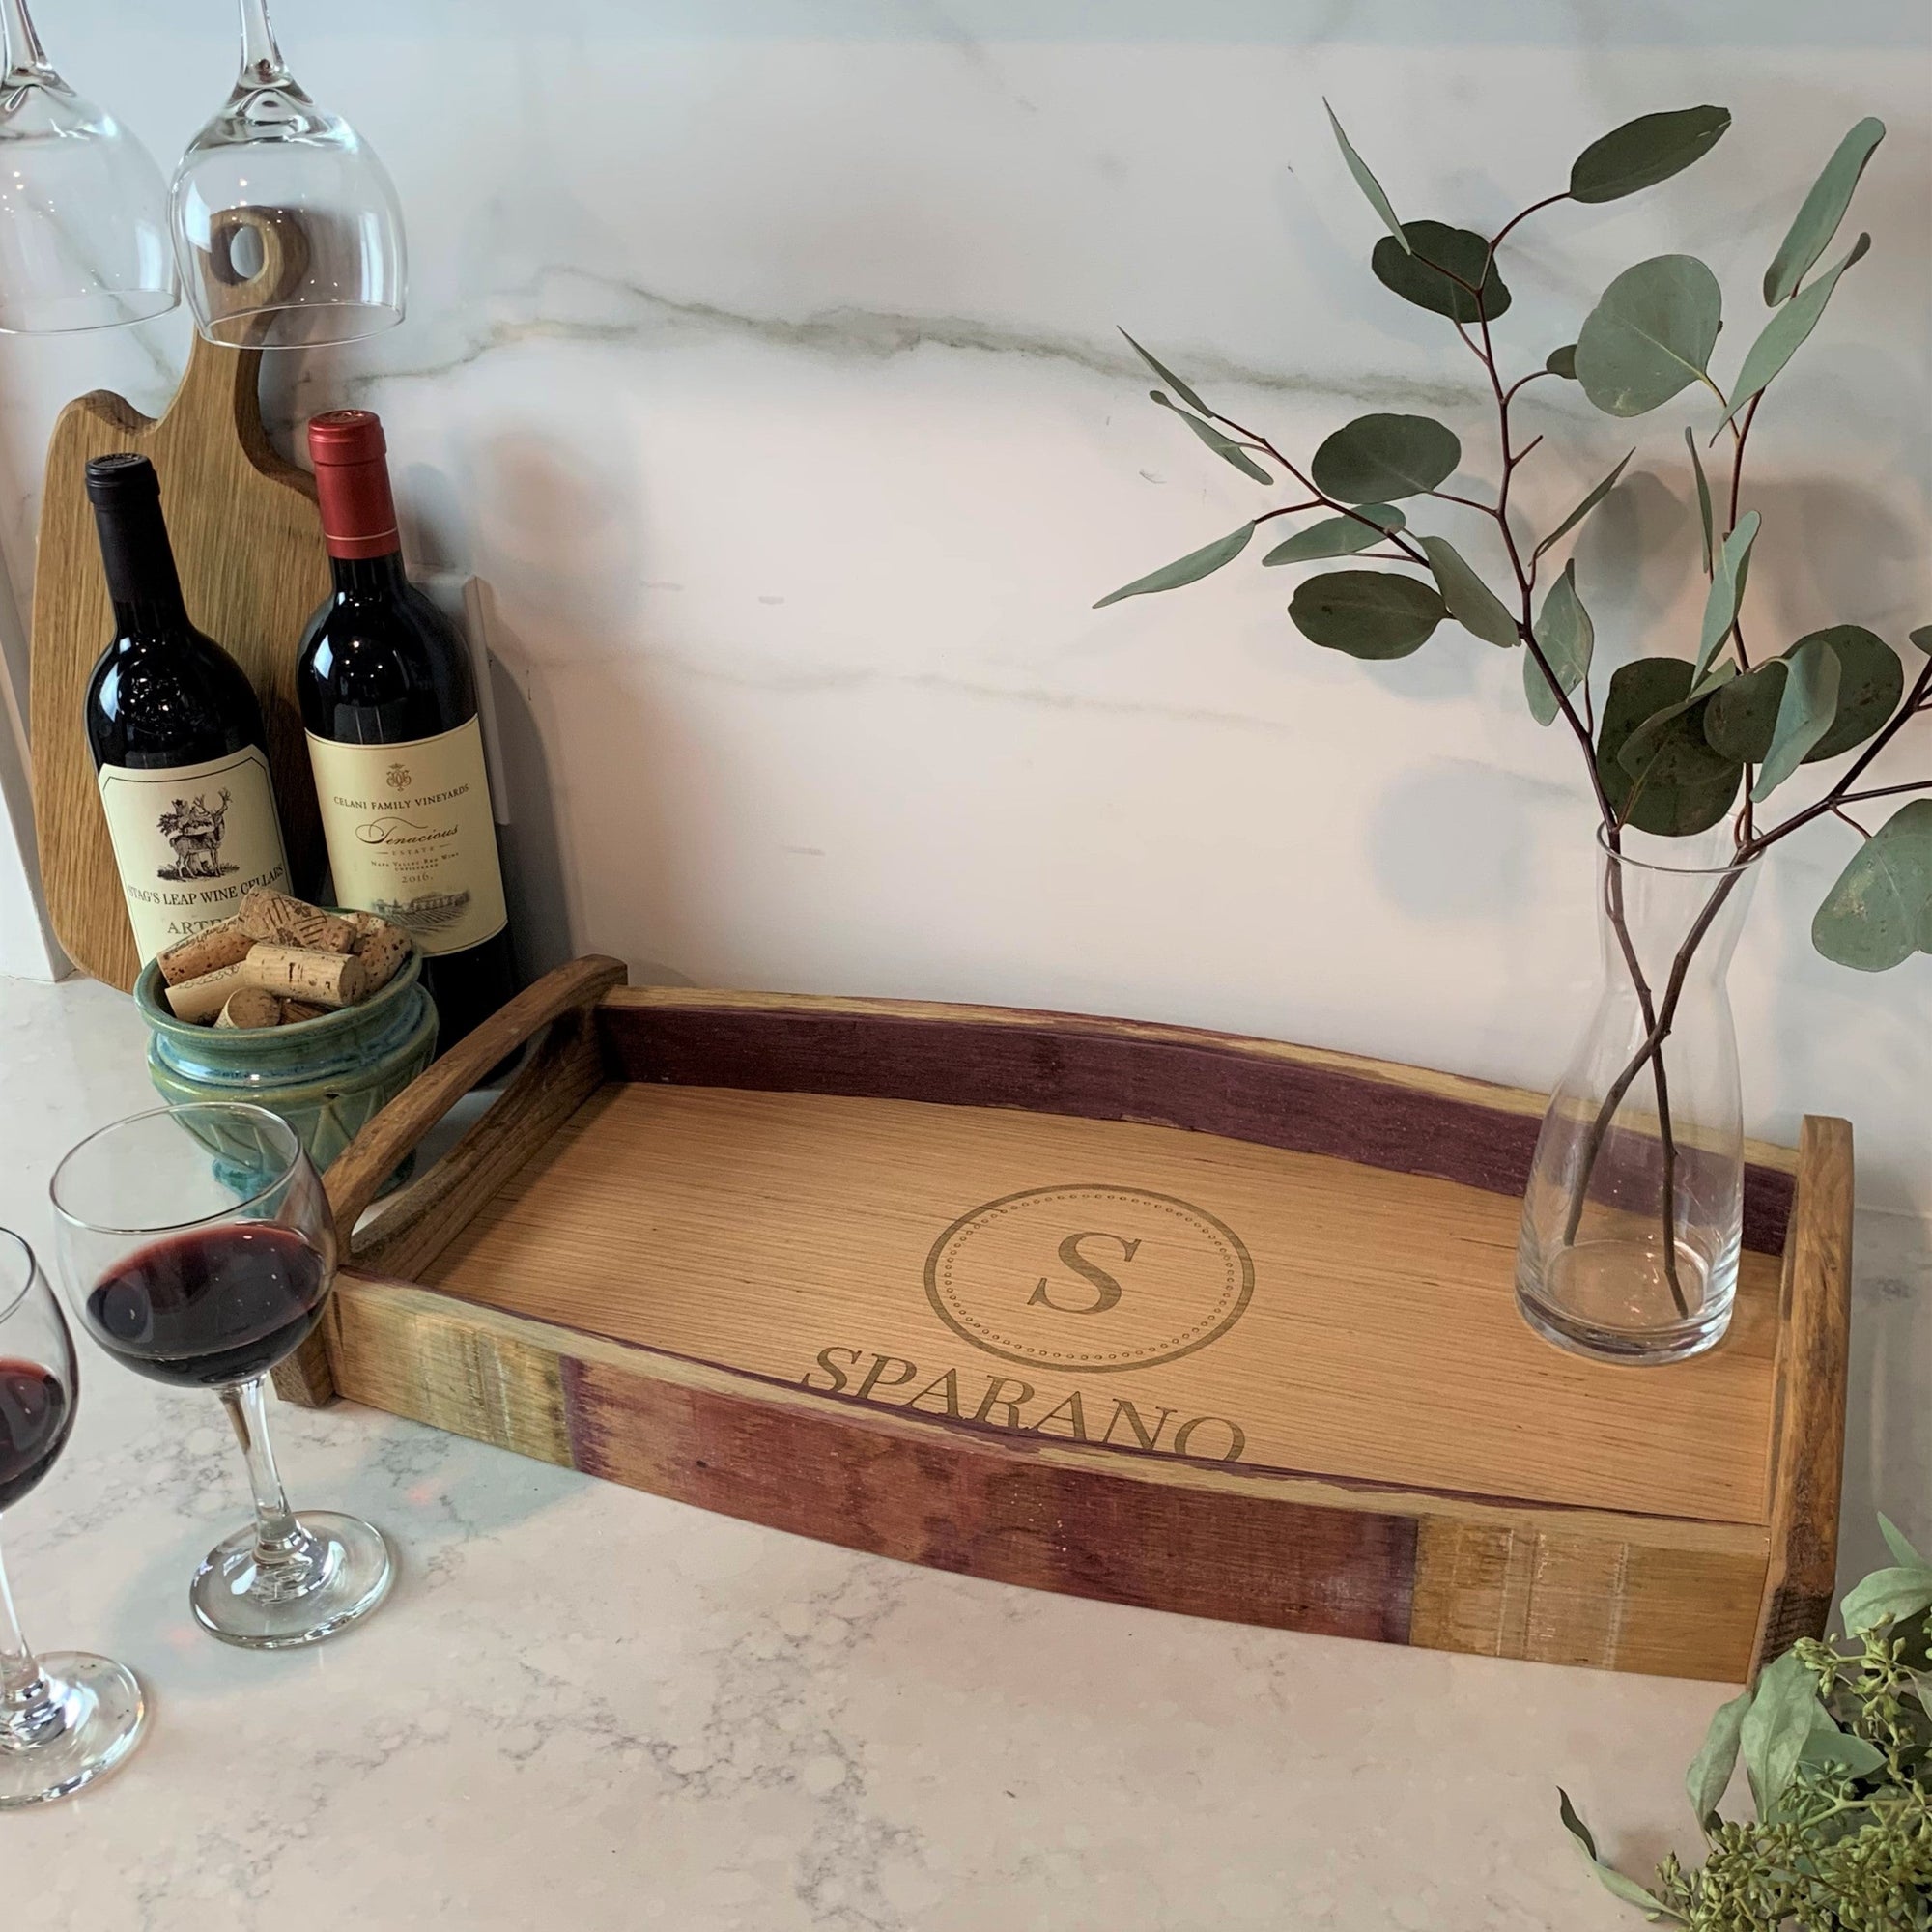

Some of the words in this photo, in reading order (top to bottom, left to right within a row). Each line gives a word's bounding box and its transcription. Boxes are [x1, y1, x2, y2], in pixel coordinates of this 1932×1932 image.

[334, 796, 367, 810] CELANI
[372, 800, 411, 810] FAMILY
[415, 784, 469, 807] VINEYARDS
[355, 816, 459, 845] Tenacious
[163, 893, 197, 906] LEAP
[200, 885, 239, 904] WINE
[1027, 1231, 1143, 1315] S
[801, 1346, 1246, 1463] SPARANO
